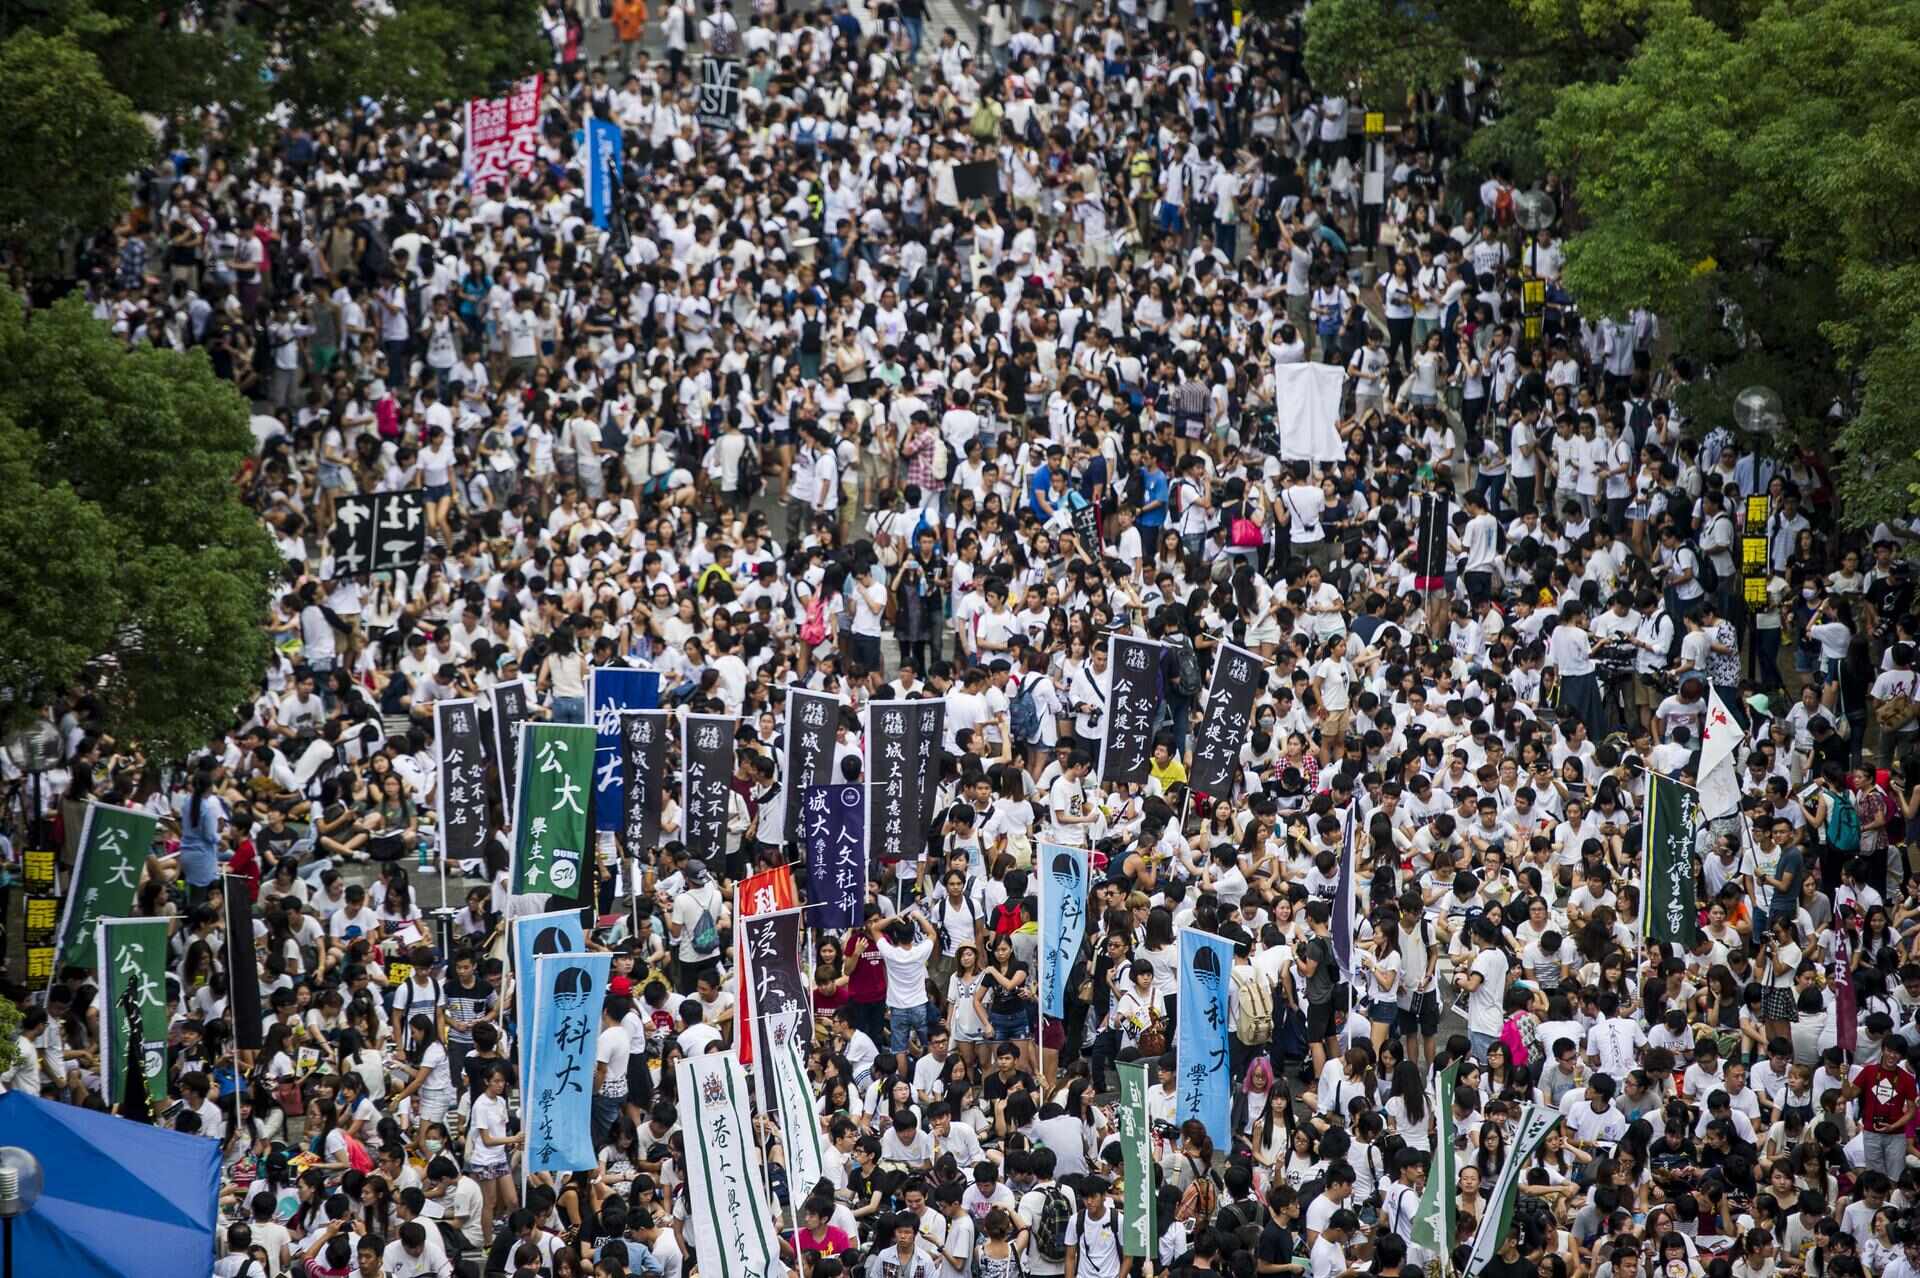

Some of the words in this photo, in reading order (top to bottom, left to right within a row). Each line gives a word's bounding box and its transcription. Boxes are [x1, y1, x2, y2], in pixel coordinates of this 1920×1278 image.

[1109, 678, 1134, 750] 公民提名
[1128, 698, 1153, 772] 必不可少
[1197, 688, 1233, 760] 公民提名
[1210, 713, 1246, 785] 必不可少
[444, 748, 470, 825] 公民提名
[467, 764, 488, 848] 必不可少
[536, 740, 584, 815] 公大
[688, 761, 706, 836] 公民提名
[885, 742, 906, 853] 城大創意媒體
[96, 827, 135, 888] 公大
[524, 817, 548, 886] 學生會
[705, 780, 727, 861] 必不可少
[835, 825, 858, 925] 人文社科
[751, 921, 785, 1002] 浸大
[1059, 895, 1083, 960] 科大
[114, 943, 165, 1008] 公大
[554, 1015, 591, 1096] 科大
[1185, 1064, 1208, 1119] 學生
[536, 1089, 558, 1164] 學生會
